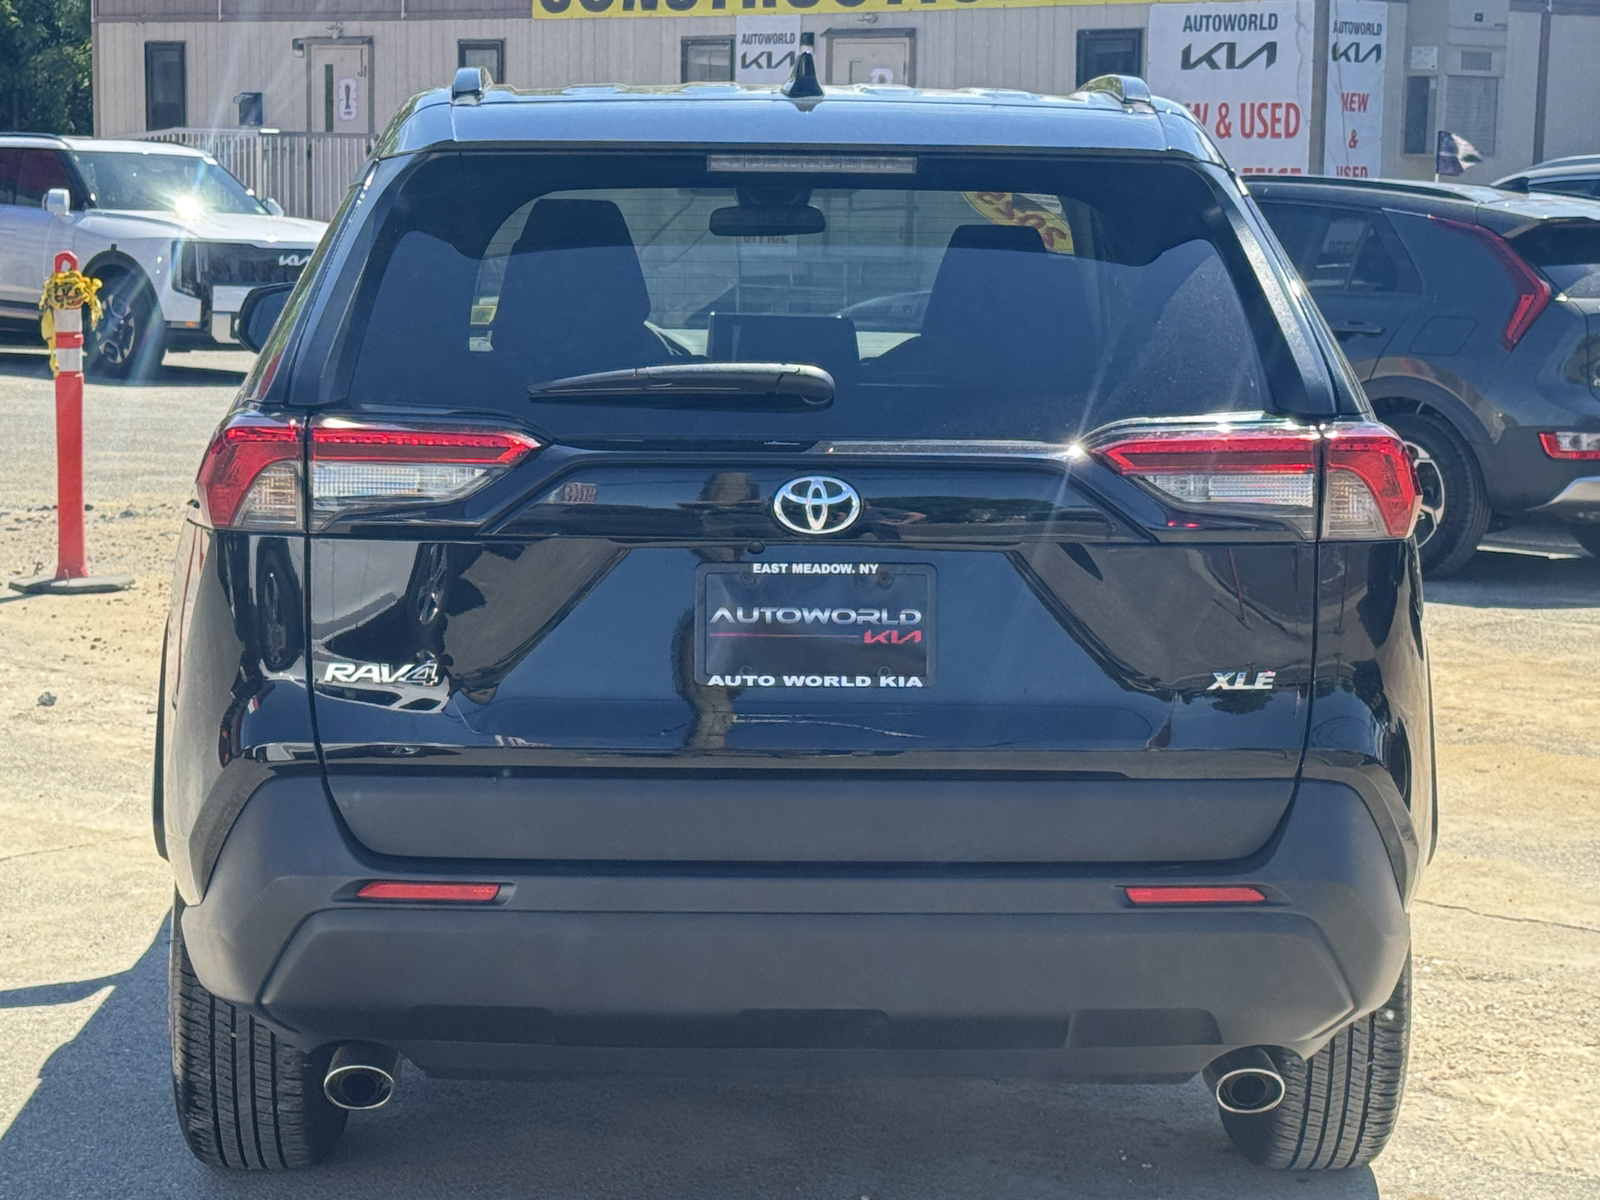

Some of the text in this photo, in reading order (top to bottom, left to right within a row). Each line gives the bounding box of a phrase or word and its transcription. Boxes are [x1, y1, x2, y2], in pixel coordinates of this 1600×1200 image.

[1182, 13, 1279, 33] AUTOWORLD
[1332, 20, 1382, 36] AUTOWORLD
[741, 33, 796, 45] AUTOWORLD
[1180, 41, 1278, 71] KIA
[1331, 41, 1382, 63] KIA
[1341, 92, 1370, 113] NEW
[1215, 102, 1232, 139] &
[1240, 102, 1300, 139] USED
[1348, 129, 1359, 149] &
[752, 563, 789, 575] EAST
[859, 563, 879, 575] NY
[709, 606, 922, 626] AUTOWORLD
[863, 629, 922, 645] KIA
[324, 662, 439, 686] RAV4
[706, 674, 924, 688] AUTO WORLD KIA
[1206, 671, 1277, 691] XLE
